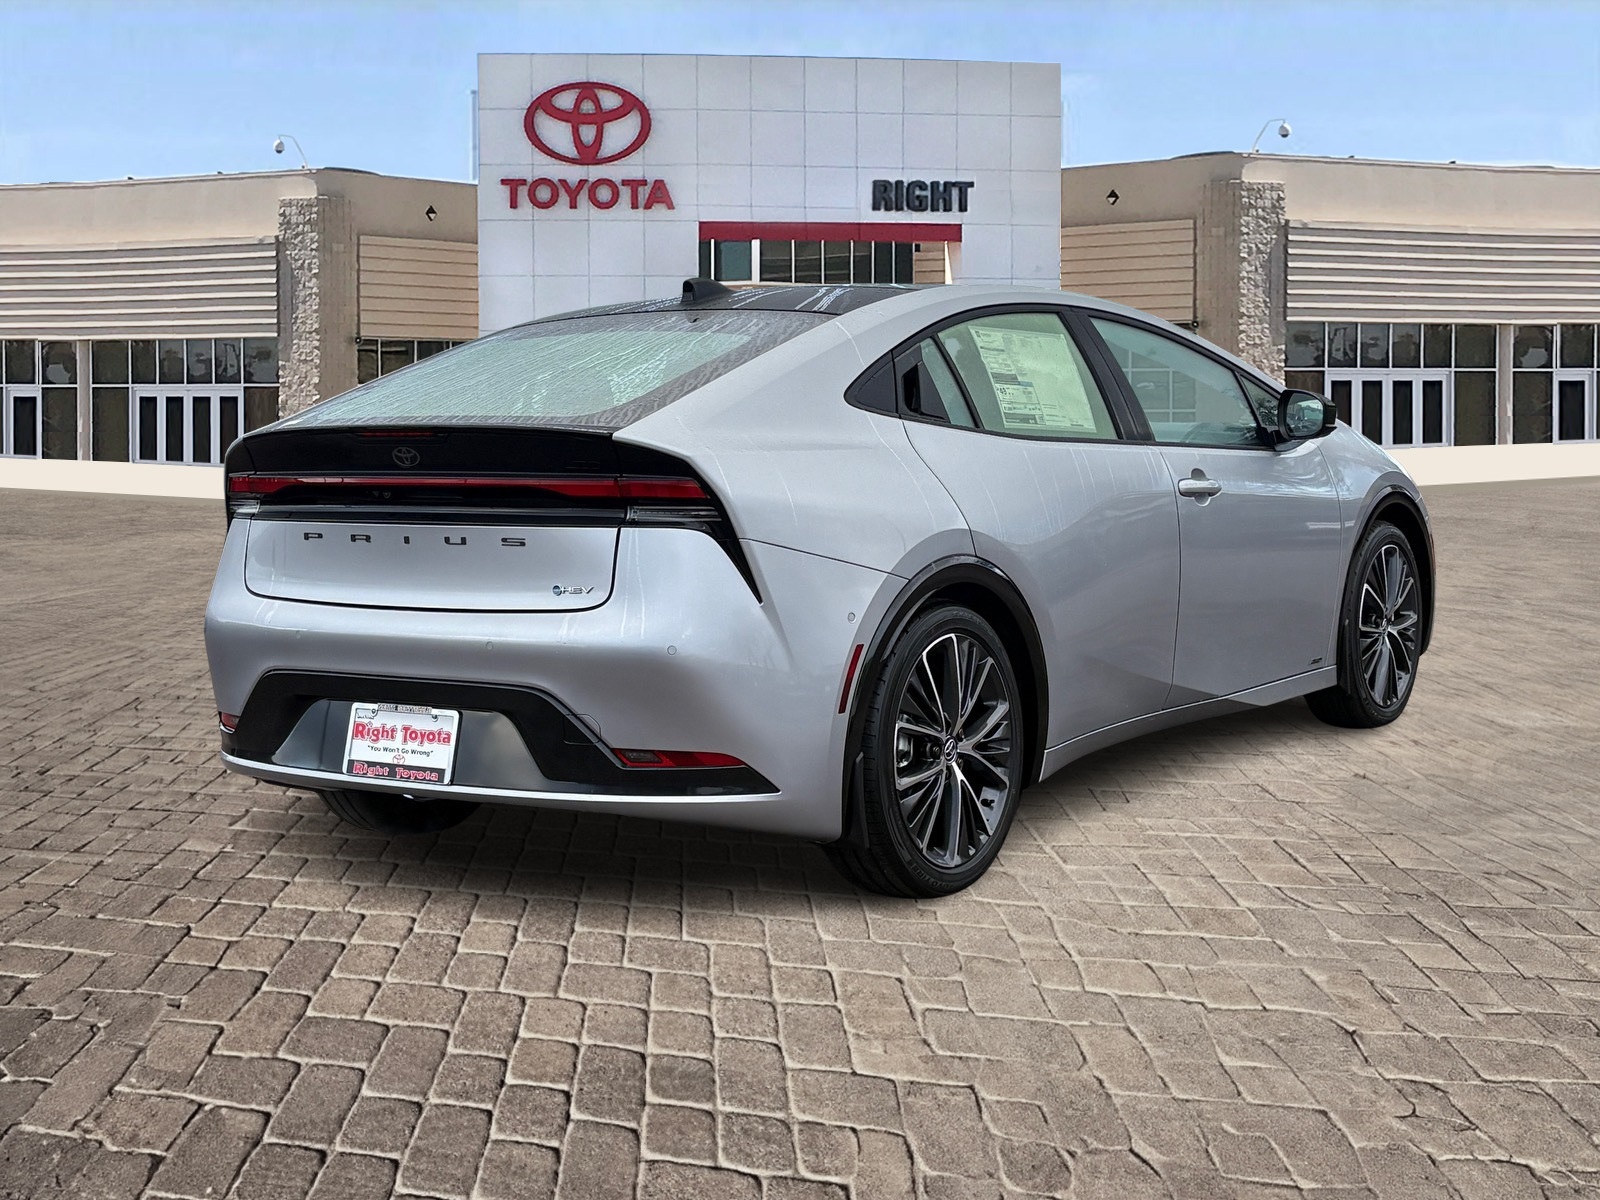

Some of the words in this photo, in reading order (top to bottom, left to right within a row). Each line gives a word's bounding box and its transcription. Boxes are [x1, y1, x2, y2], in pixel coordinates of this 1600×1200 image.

[501, 178, 675, 210] TOYOTA
[872, 180, 975, 212] RIGHT
[304, 532, 526, 547] PRIUS
[561, 586, 594, 595] HEV
[353, 721, 398, 744] Right
[401, 725, 452, 746] Toyota
[382, 746, 400, 754] Won't
[353, 762, 390, 776] Right
[396, 767, 439, 781] Toyota
